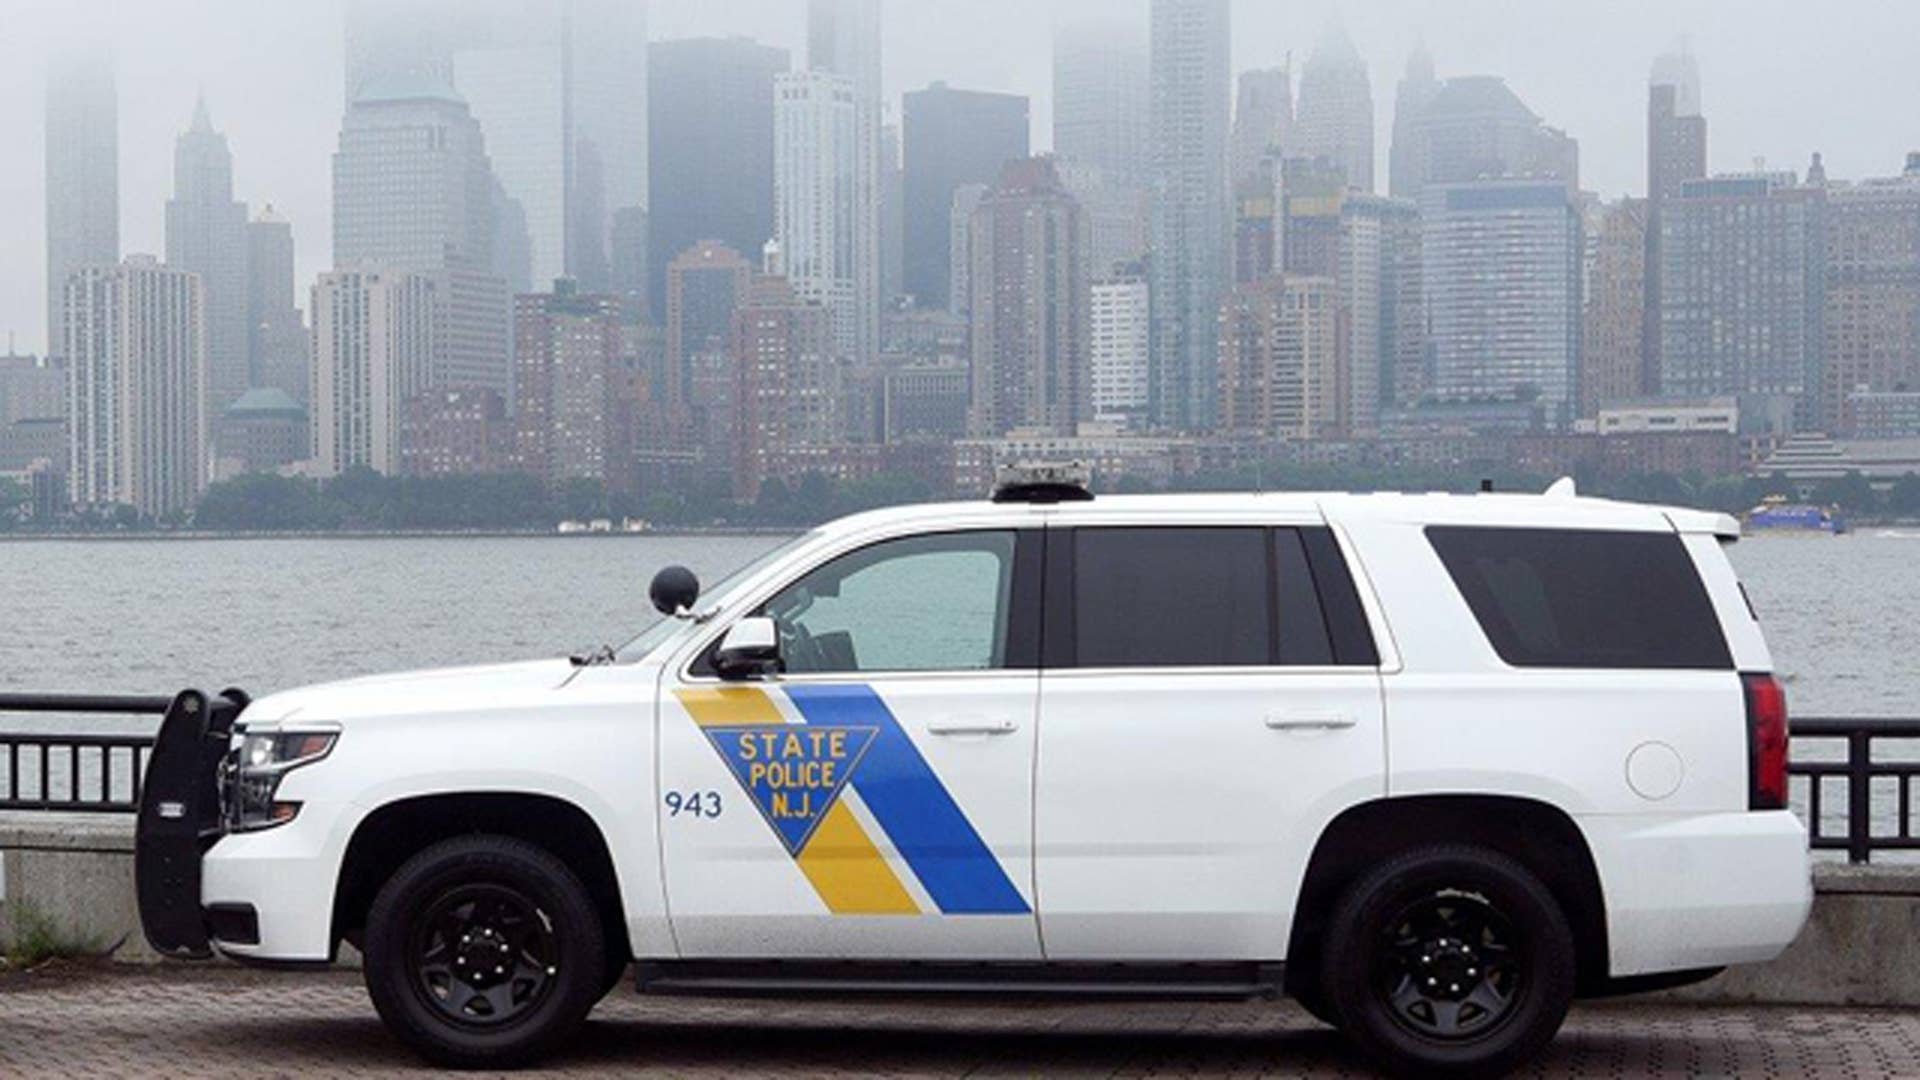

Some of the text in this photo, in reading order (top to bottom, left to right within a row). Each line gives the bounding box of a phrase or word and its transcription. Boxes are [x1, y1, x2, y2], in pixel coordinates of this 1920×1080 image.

[738, 732, 847, 760] STATE
[749, 761, 835, 788] POLICE
[664, 791, 723, 818] 943
[771, 792, 816, 818] N.J.
